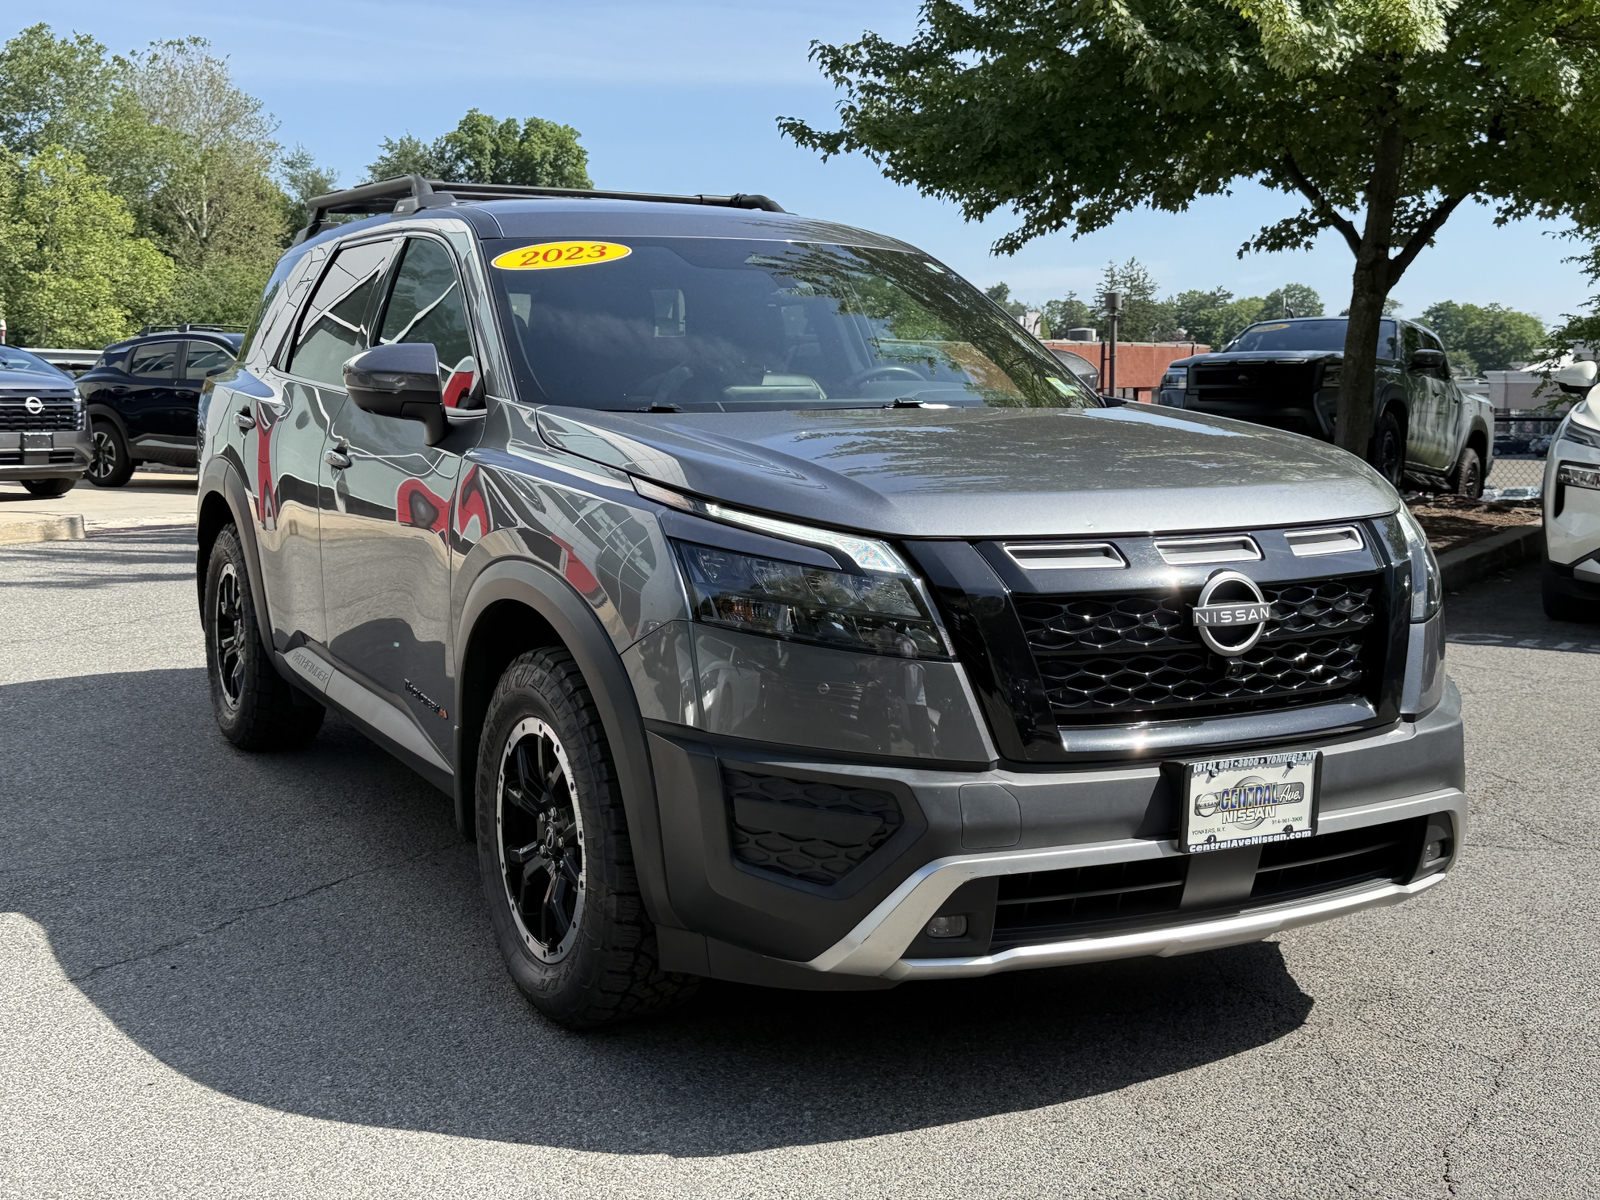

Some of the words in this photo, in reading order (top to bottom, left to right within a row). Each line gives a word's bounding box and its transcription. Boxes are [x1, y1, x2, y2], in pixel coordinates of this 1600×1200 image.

[519, 244, 608, 267] 2023
[1195, 606, 1270, 624] NISSAN
[1221, 783, 1278, 810] CENTRAL
[1222, 806, 1276, 824] NISSAN
